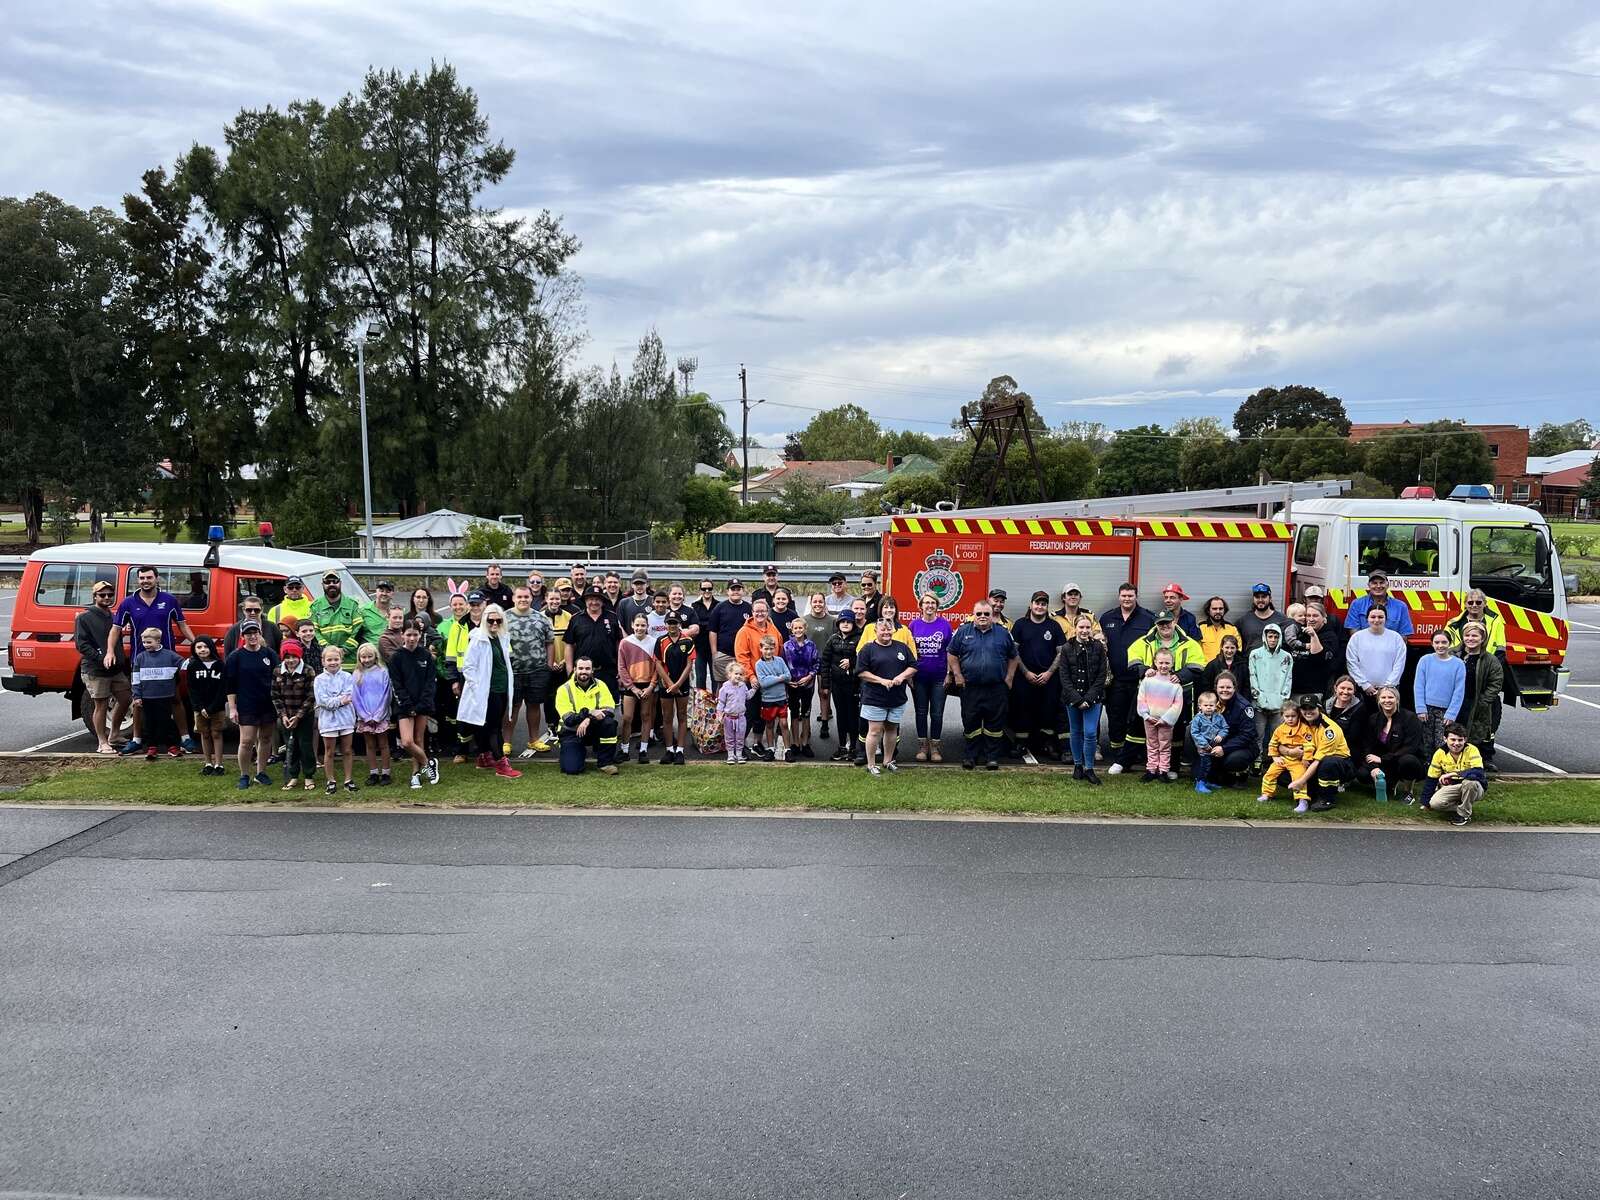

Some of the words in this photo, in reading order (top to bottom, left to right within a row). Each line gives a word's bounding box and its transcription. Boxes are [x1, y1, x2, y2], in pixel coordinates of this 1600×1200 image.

[1030, 541, 1064, 550] FEDERATION
[1065, 541, 1092, 550] SUPPORT
[1403, 580, 1430, 589] SUPPORT
[941, 612, 970, 622] SUPPOR
